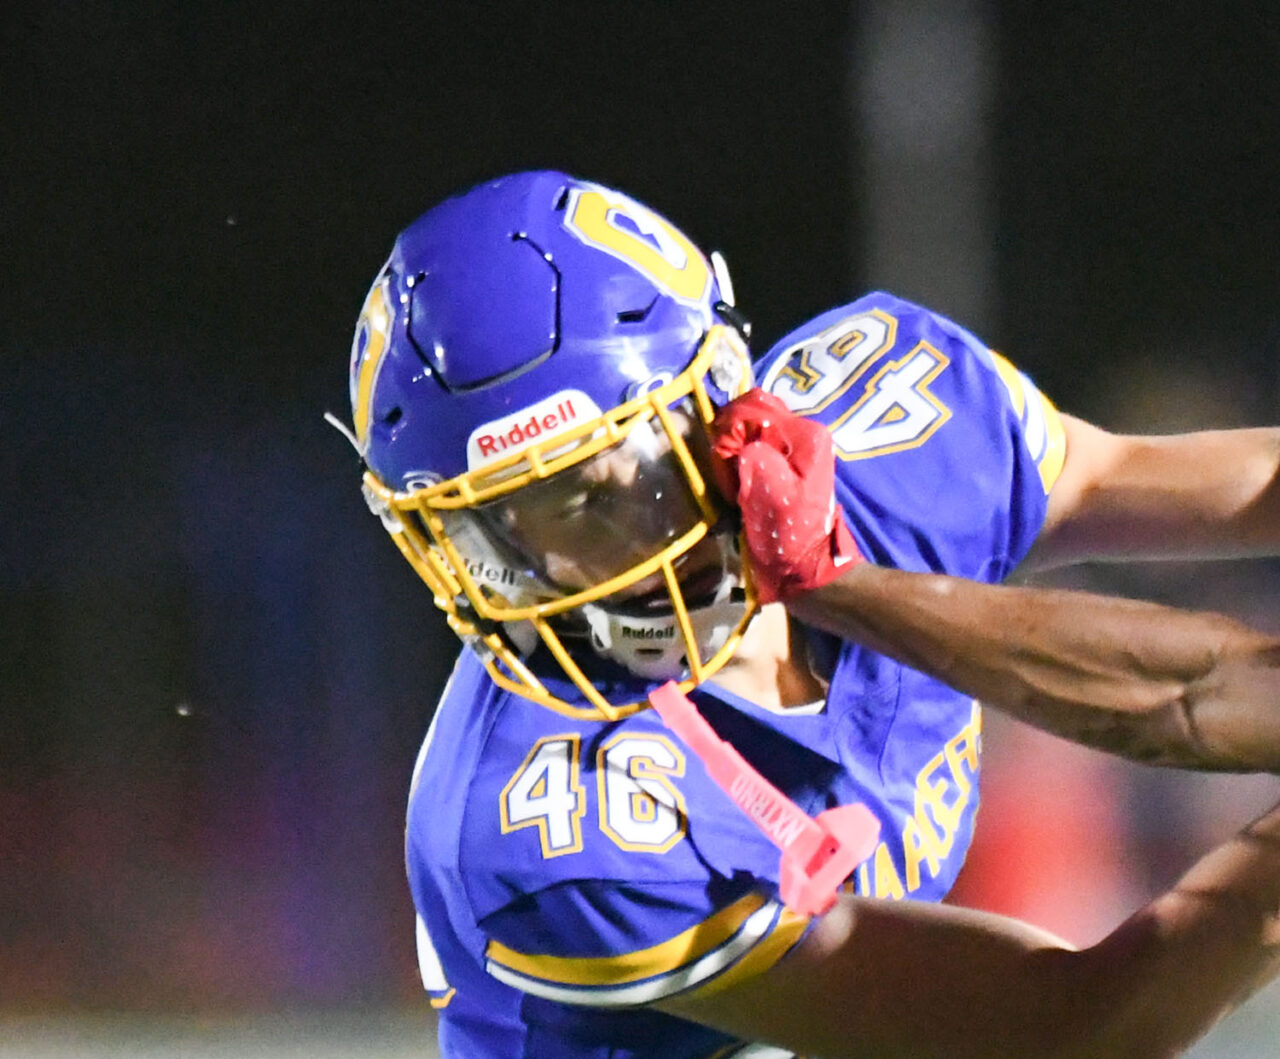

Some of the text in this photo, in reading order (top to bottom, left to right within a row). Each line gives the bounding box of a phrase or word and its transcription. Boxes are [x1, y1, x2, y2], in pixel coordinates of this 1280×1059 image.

[476, 399, 577, 457] Riddell
[761, 308, 953, 462] 46
[622, 625, 675, 639] Riddell
[499, 732, 687, 860] 46
